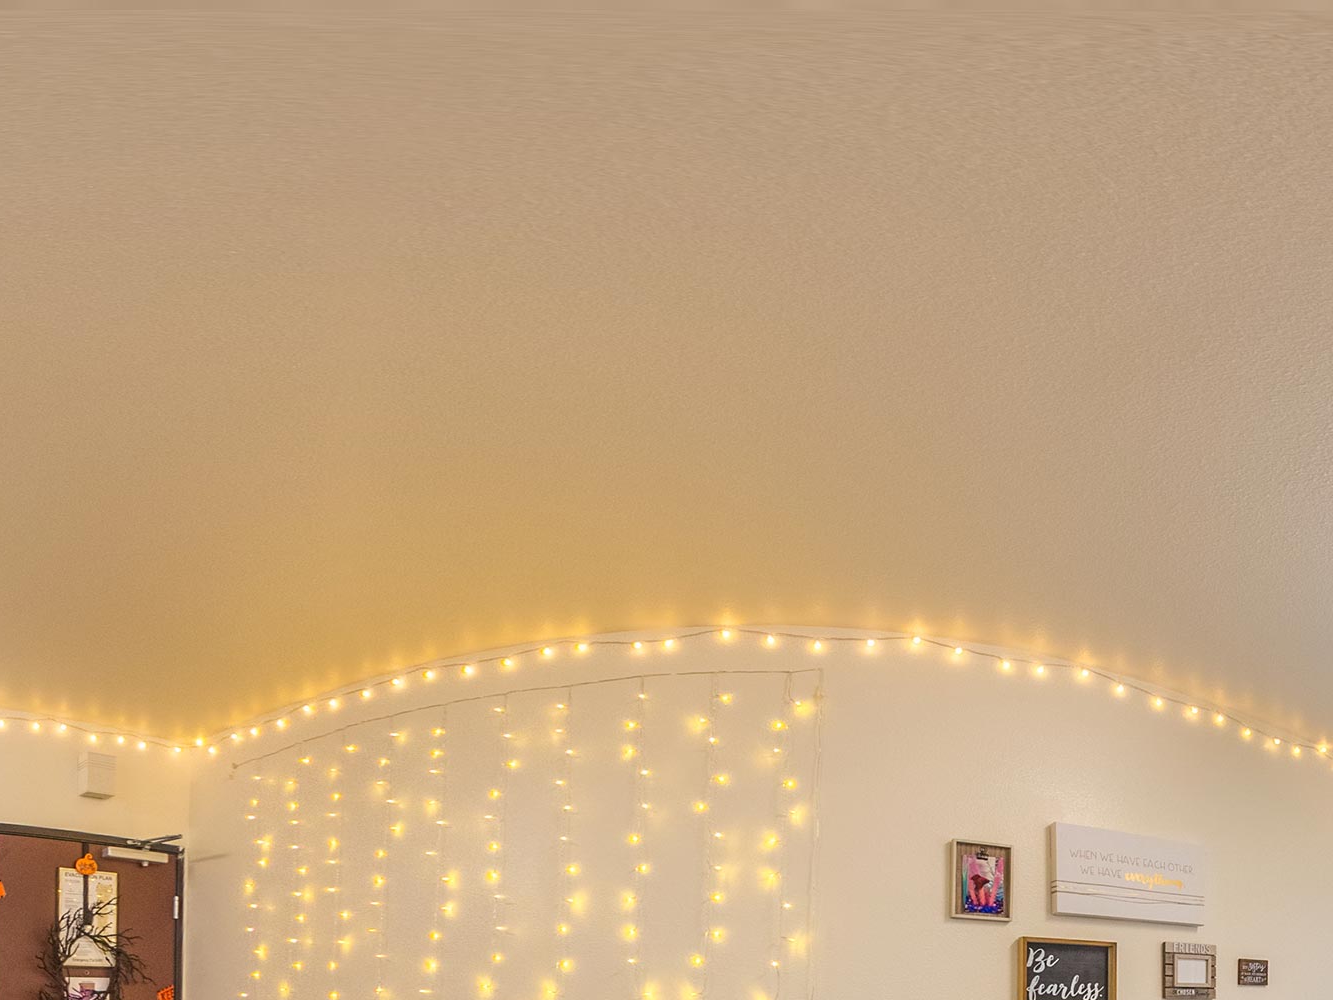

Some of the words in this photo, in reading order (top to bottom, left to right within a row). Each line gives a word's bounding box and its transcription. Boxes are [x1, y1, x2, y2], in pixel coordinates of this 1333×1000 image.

[1069, 848, 1098, 860] WHEN
[1099, 851, 1114, 863] WE
[1117, 855, 1141, 866] HAVE
[1143, 859, 1166, 870] EACH
[1079, 865, 1095, 875] WE
[1097, 867, 1122, 879] HAVE
[1173, 942, 1211, 955] FRIENDS
[1026, 947, 1060, 973] Be
